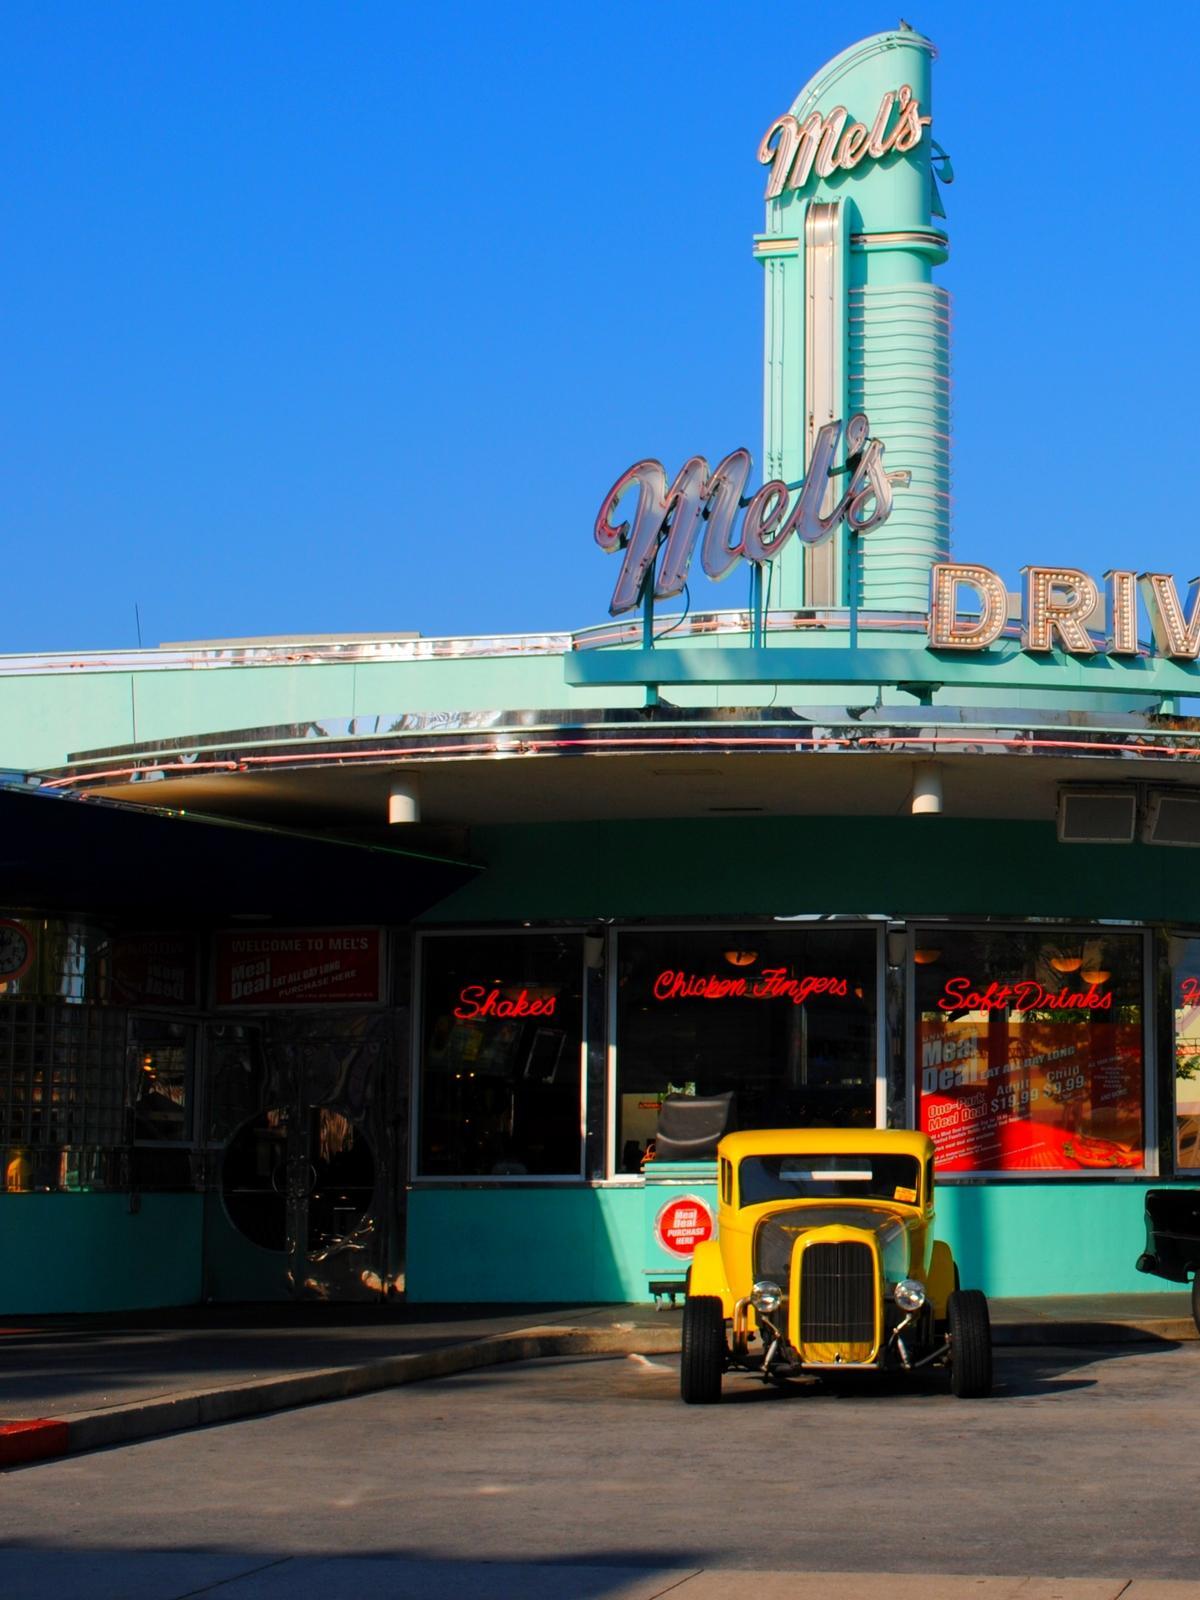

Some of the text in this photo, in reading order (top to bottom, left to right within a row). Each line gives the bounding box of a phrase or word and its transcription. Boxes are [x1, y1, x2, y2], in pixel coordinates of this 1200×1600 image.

[757, 84, 932, 201] Mel's
[594, 413, 911, 617] Mel's
[231, 937, 369, 952] WELCOME TO MEL'S
[231, 957, 271, 982] Meal
[272, 960, 341, 988] EAT ALL DAY LONG
[231, 974, 271, 1000] Deal
[278, 969, 358, 998] PURCHASE HERE
[654, 967, 848, 1004] Chicken Fingers
[937, 977, 1113, 1012] Soft Drinks
[454, 986, 556, 1018] Shakes
[922, 1035, 977, 1067] Meal
[1024, 1055, 1046, 1067] DAY
[1047, 1046, 1075, 1061] LONG
[922, 1056, 977, 1093] Deal
[1043, 1075, 1084, 1098] $9.99
[1047, 1065, 1079, 1082] Child
[991, 1088, 1039, 1113] $19.99
[996, 1079, 1029, 1097] Adult
[928, 1092, 986, 1118] One-Park
[928, 1111, 960, 1131] Meal
[961, 1103, 988, 1122] Deal
[667, 1227, 705, 1238] PURCHASE
[675, 1236, 694, 1246] HERE
